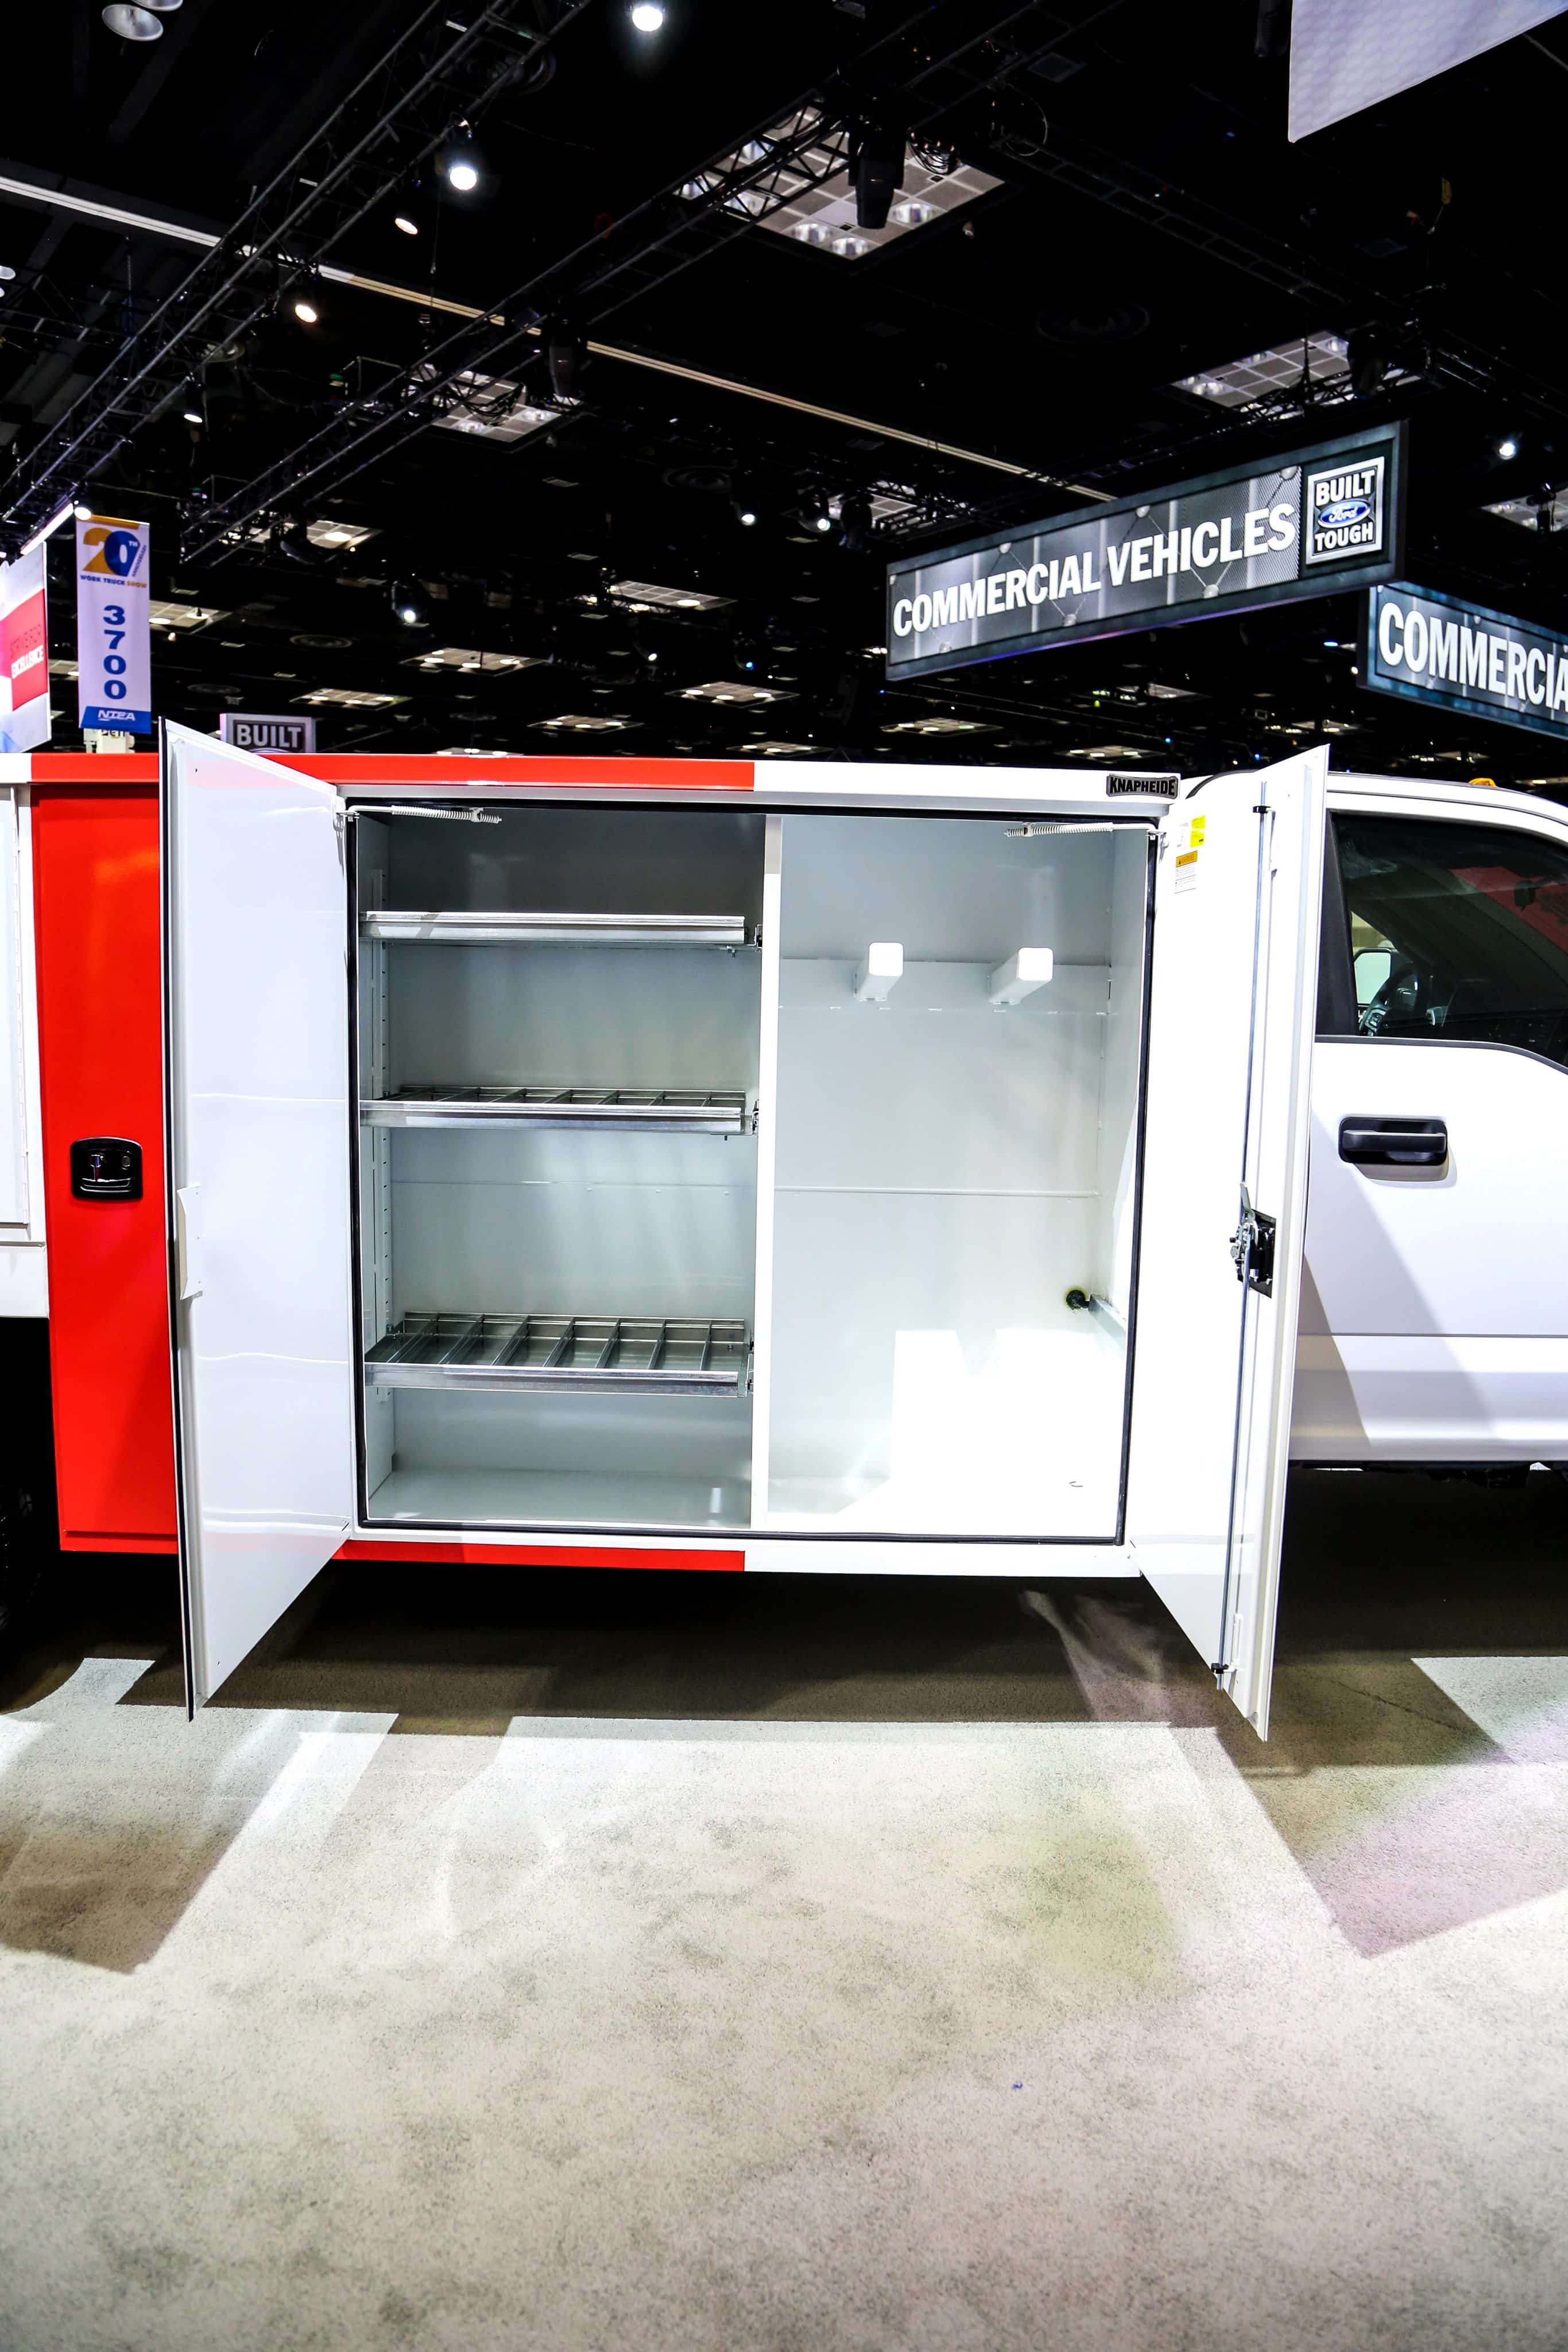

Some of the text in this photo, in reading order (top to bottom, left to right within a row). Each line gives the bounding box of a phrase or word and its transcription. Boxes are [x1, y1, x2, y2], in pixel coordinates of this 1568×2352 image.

[1315, 470, 1375, 506] BUILT
[1329, 505, 1358, 523] Ford
[1315, 521, 1373, 551] TOUGH
[893, 503, 1296, 637] COMMERCIAL VEHICLES
[237, 724, 301, 748] BUILT
[1110, 776, 1176, 796] KNAPHEIDE
